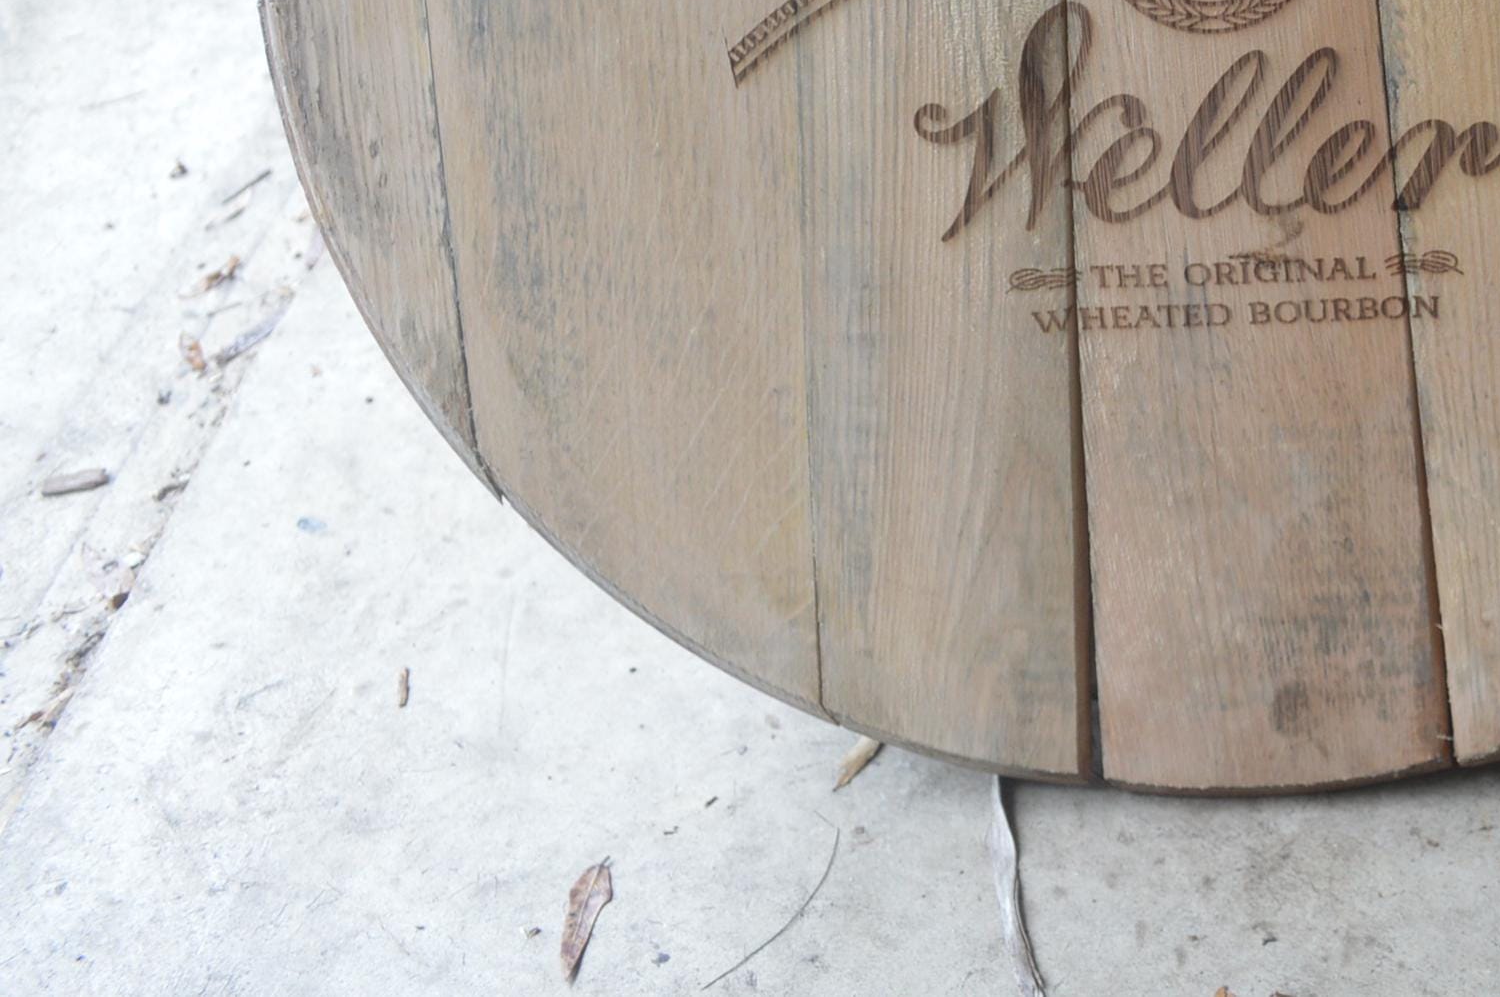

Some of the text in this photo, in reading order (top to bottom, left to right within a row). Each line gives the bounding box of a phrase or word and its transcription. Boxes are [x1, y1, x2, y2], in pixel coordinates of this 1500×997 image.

[1090, 255, 1378, 289] THE ORIGINAL
[1032, 295, 1440, 334] WHEATED BOURBON
